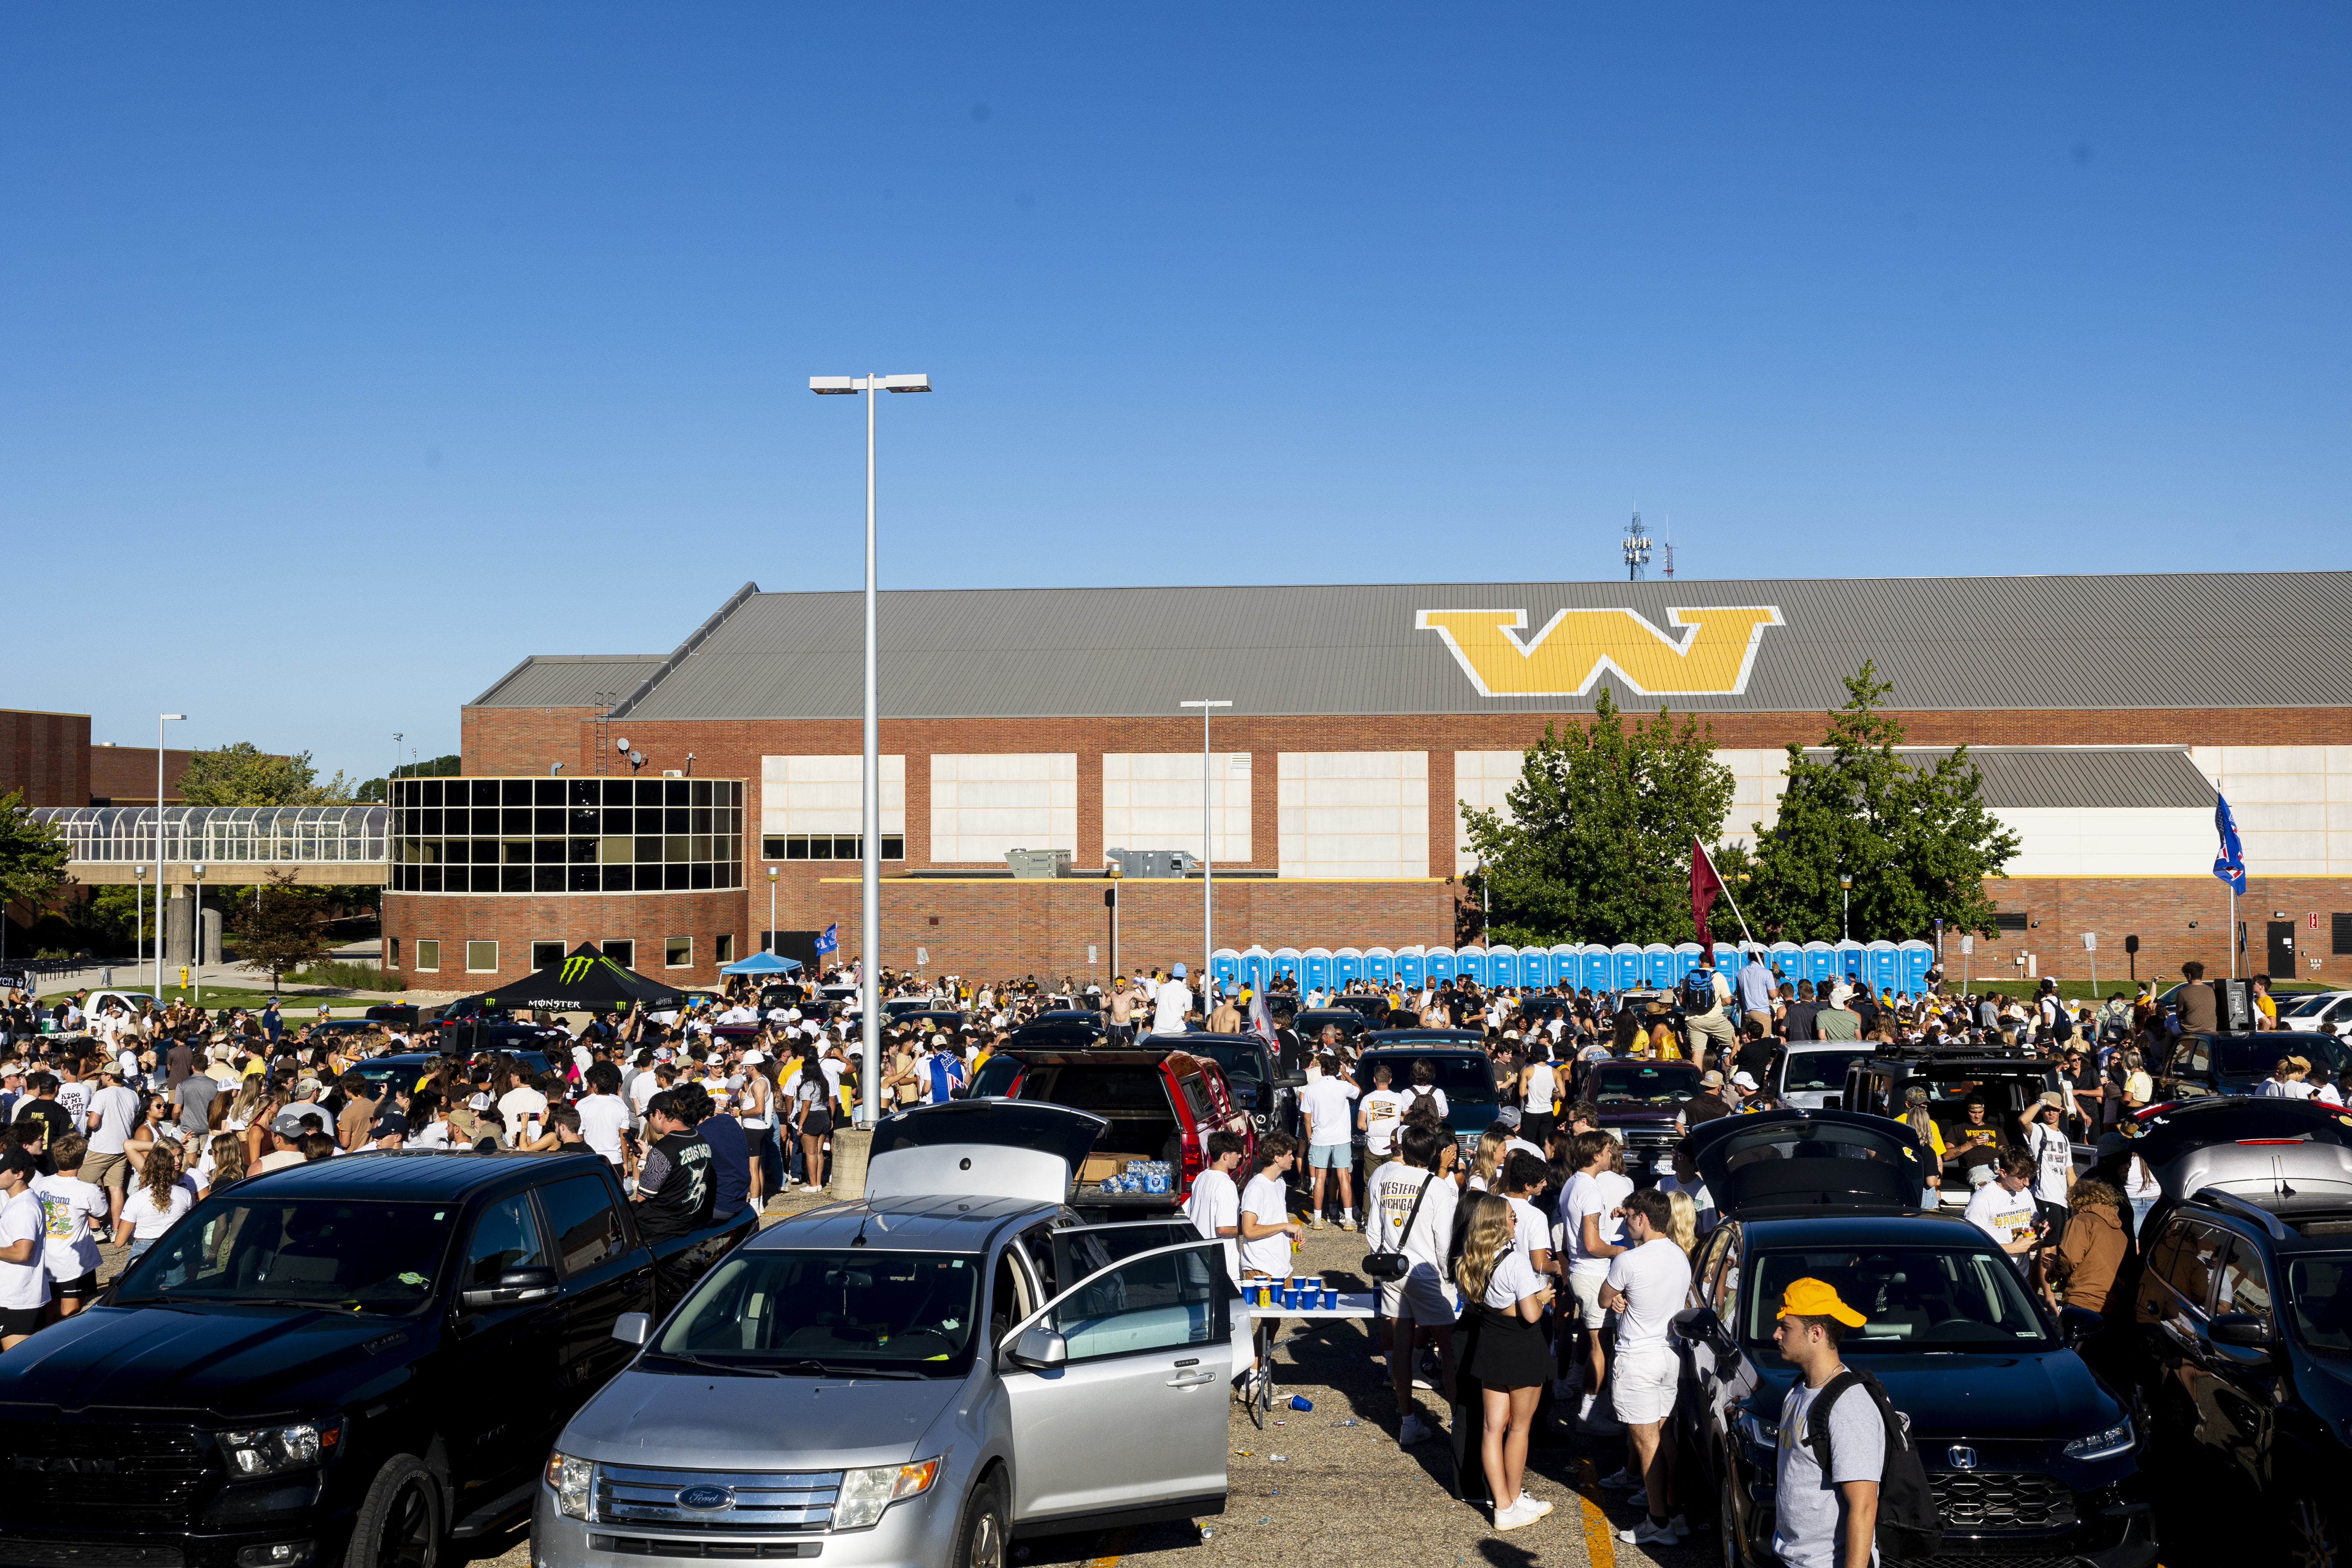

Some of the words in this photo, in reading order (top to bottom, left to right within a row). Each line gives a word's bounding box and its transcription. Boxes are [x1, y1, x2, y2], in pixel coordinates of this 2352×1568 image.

[1416, 605, 1786, 697] W
[41, 1191, 70, 1205] Corona
[1380, 1198, 1419, 1213] MICHIGA
[1996, 1210, 2015, 1218] WESTERN
[15, 1456, 115, 1474] RAM
[689, 1490, 718, 1504] Ford
